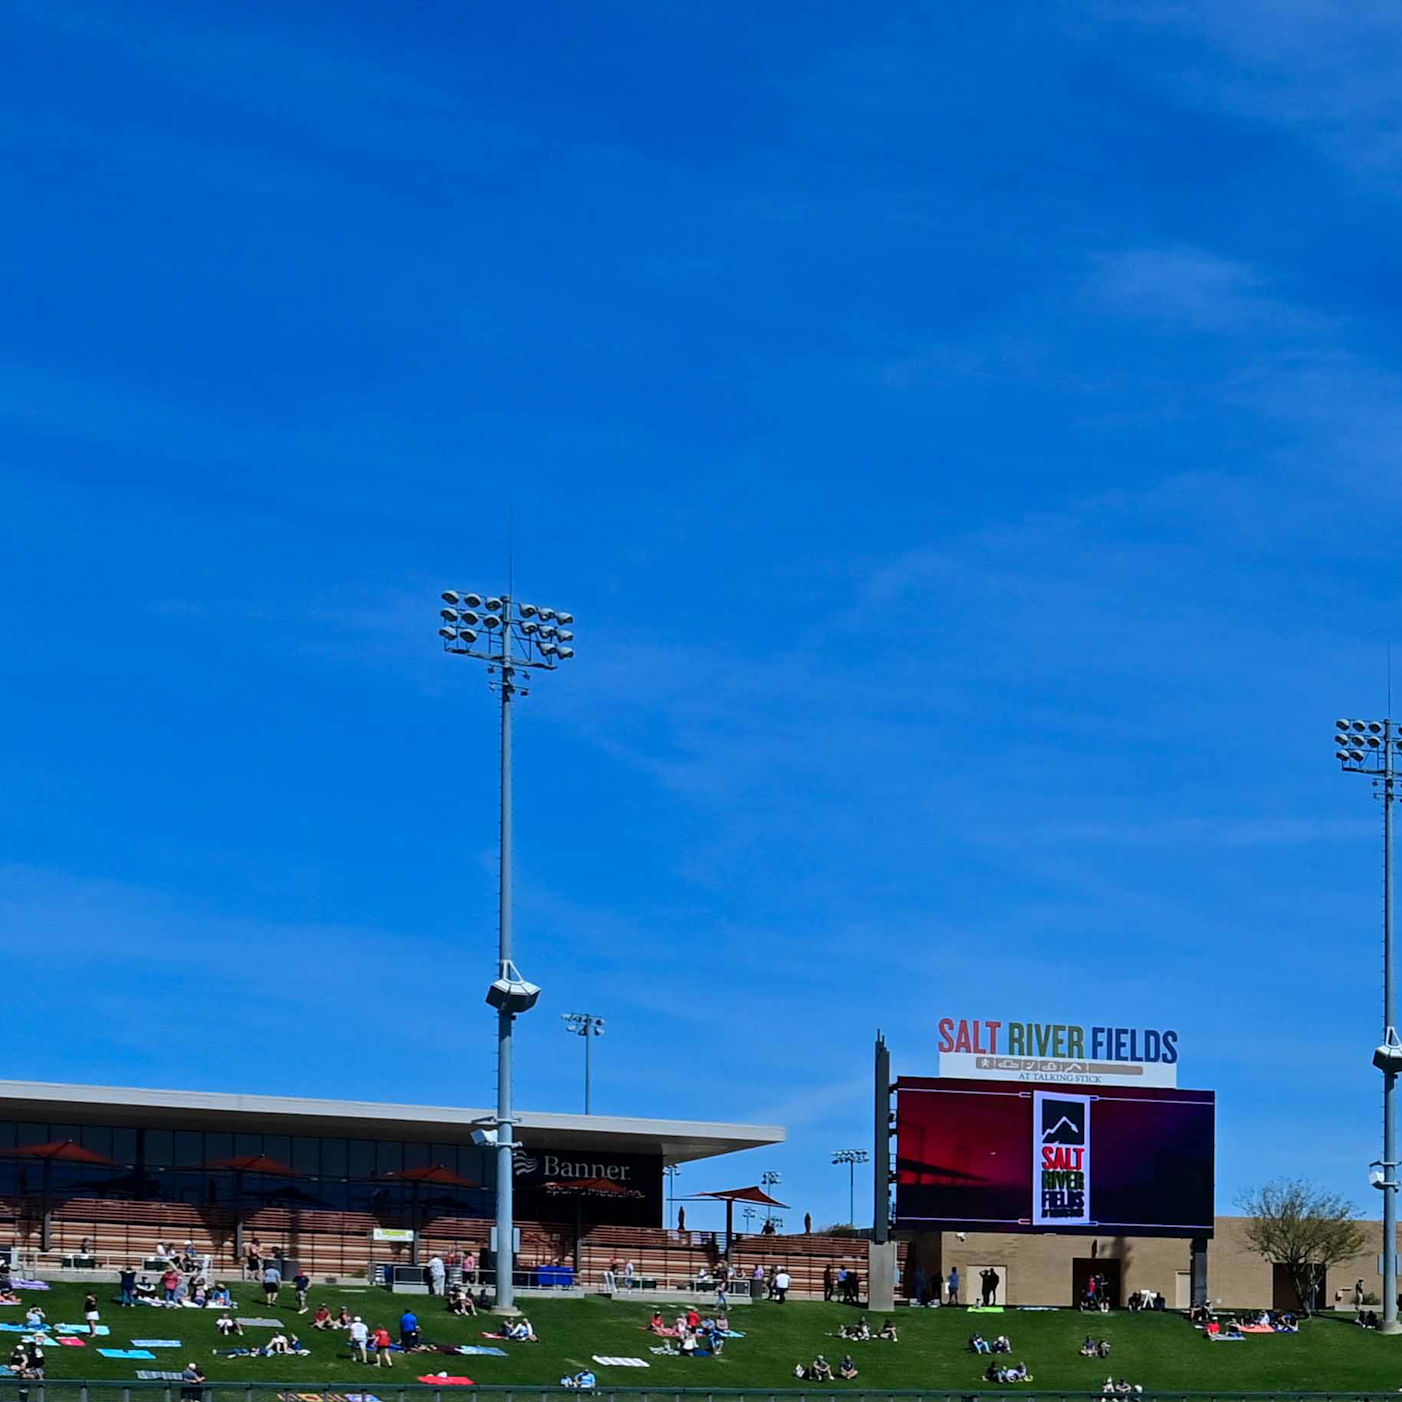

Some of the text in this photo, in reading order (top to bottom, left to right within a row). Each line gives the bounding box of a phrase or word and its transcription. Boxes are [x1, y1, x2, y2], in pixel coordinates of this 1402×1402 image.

[938, 1018, 1178, 1064] SALT RIVER FIELDS
[1019, 1072, 1102, 1083] AT TALKING STICK
[544, 1155, 630, 1180] Banner
[1042, 1146, 1085, 1170] SALT
[1042, 1170, 1085, 1190] RIVER
[1042, 1190, 1084, 1209] FIELDS
